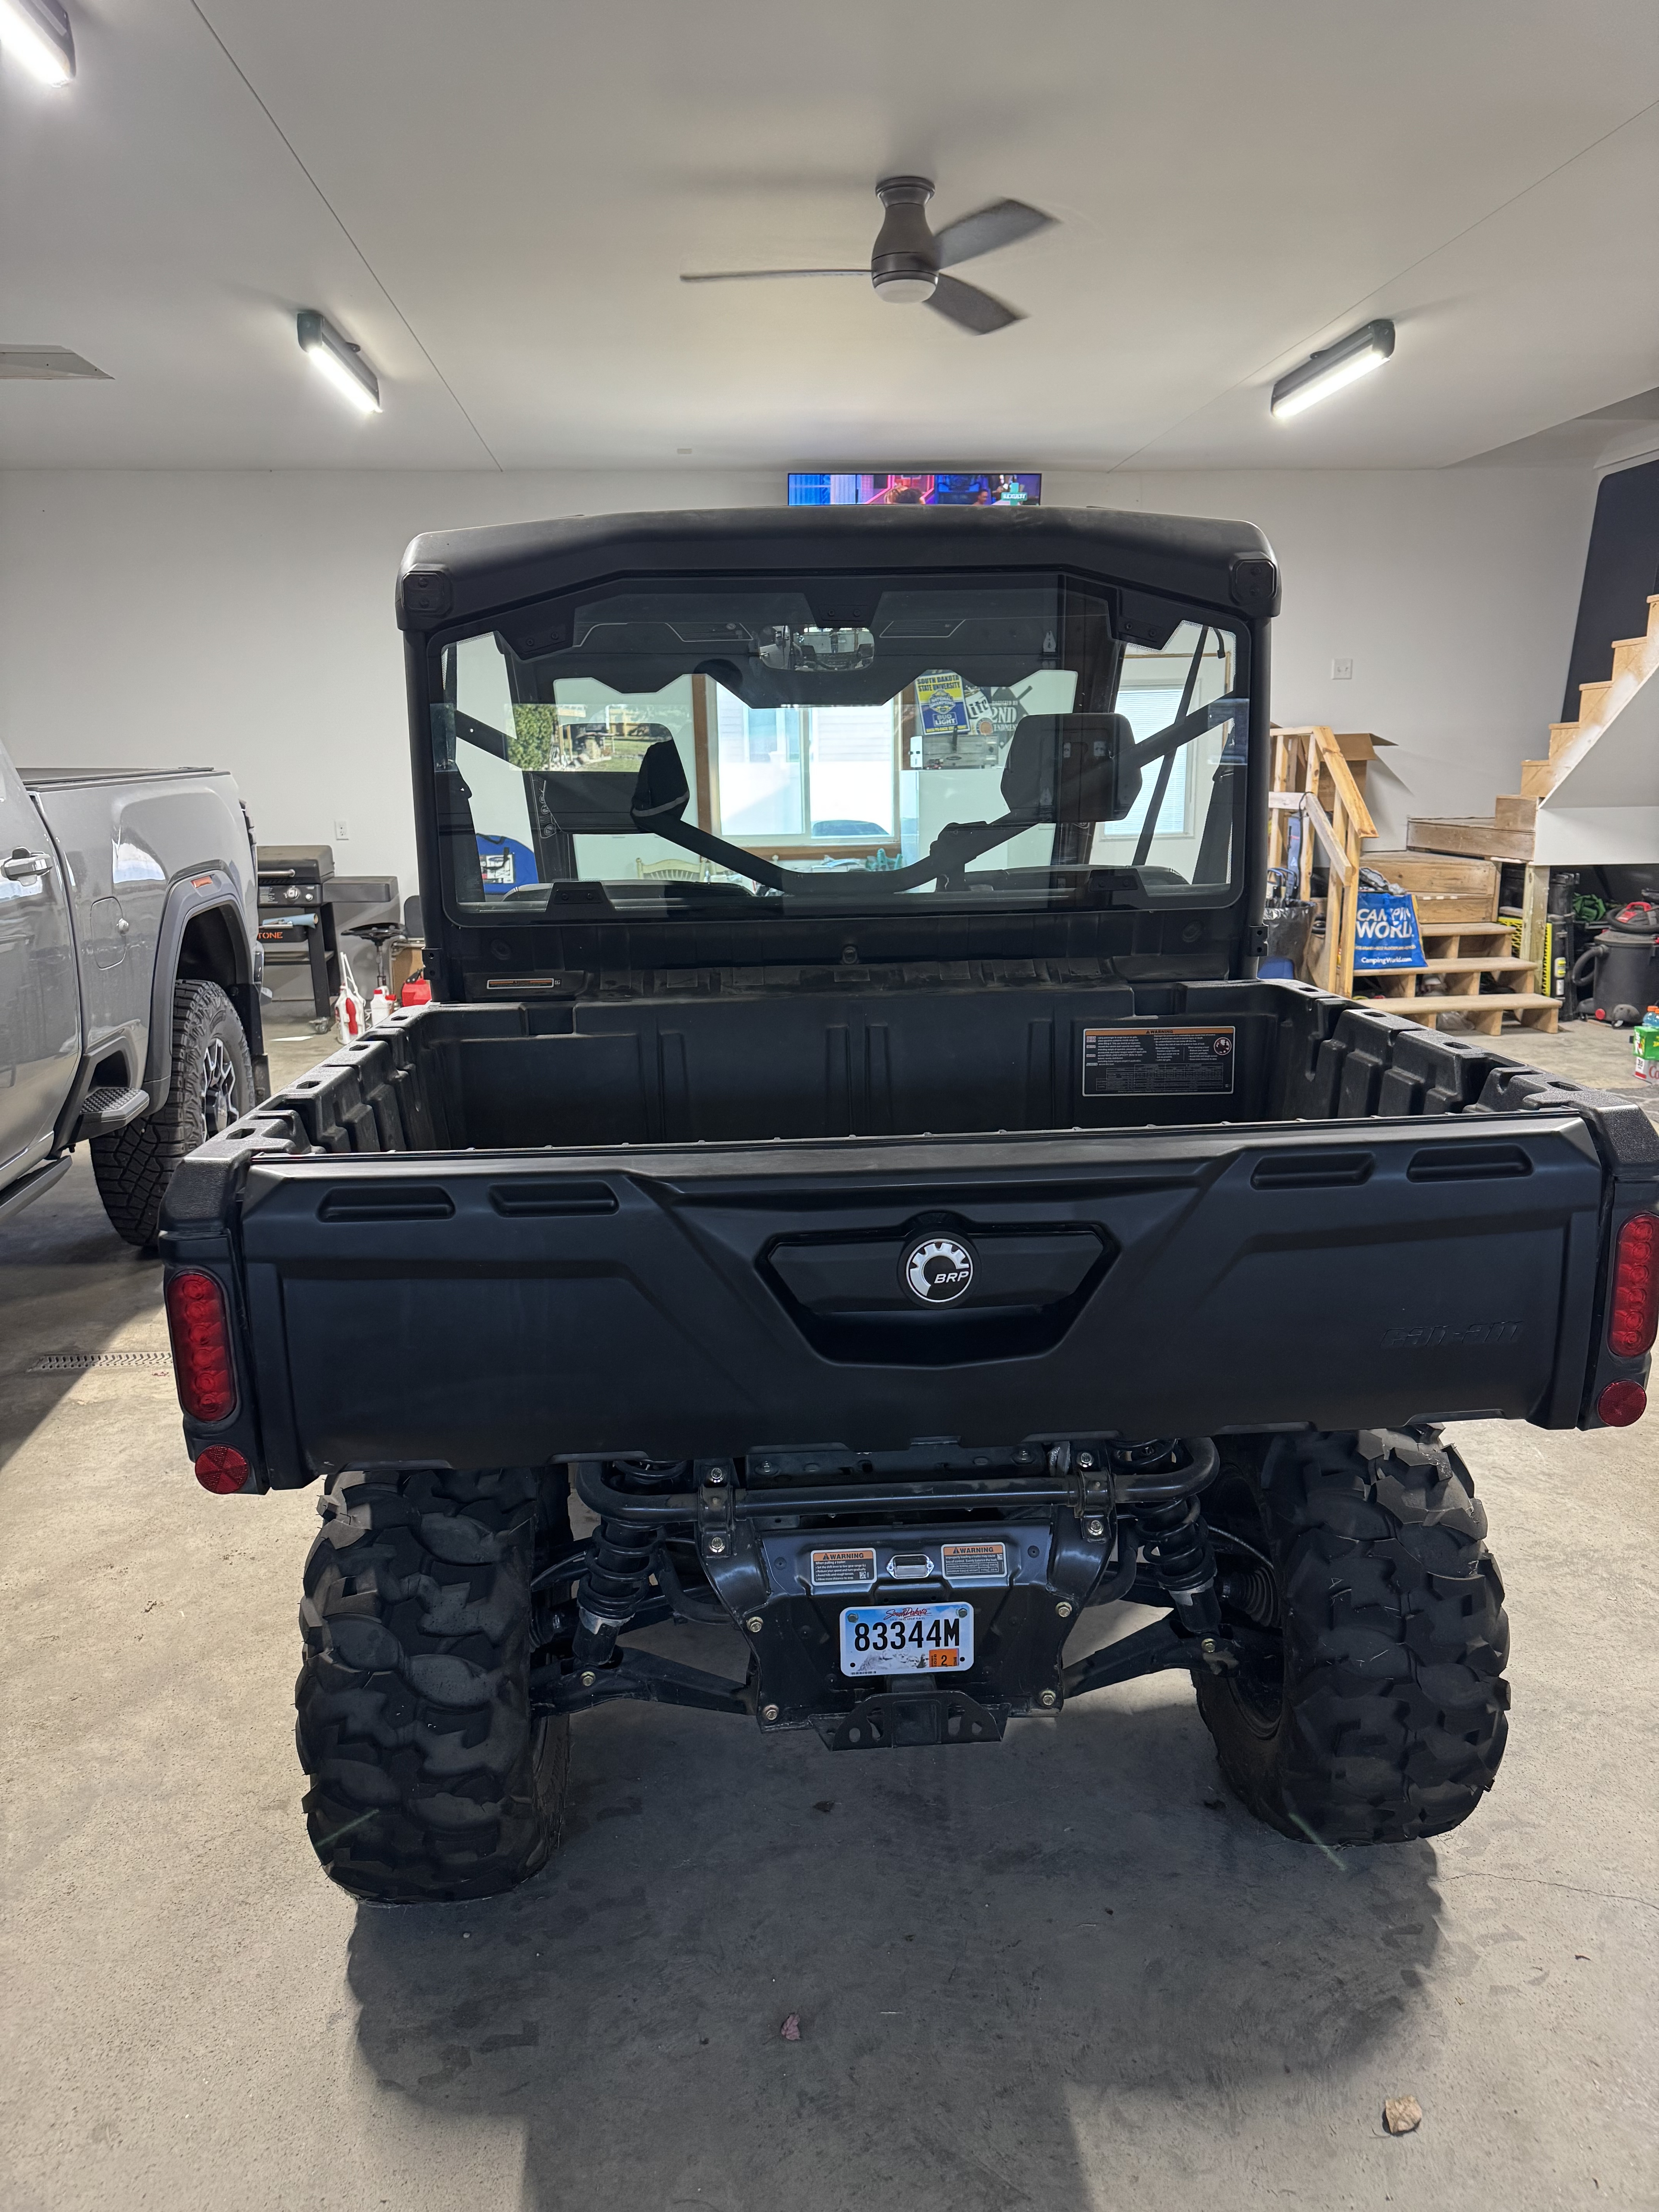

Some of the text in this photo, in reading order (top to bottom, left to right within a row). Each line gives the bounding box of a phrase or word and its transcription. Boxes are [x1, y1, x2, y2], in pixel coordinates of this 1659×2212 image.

[933, 682, 960, 690] UNIVERSITY
[992, 707, 1017, 723] 2ND
[934, 1271, 970, 1284] BRP
[883, 1607, 933, 1620] South Dakota
[855, 1618, 959, 1651] 83344M
[941, 1655, 947, 1666] 2
